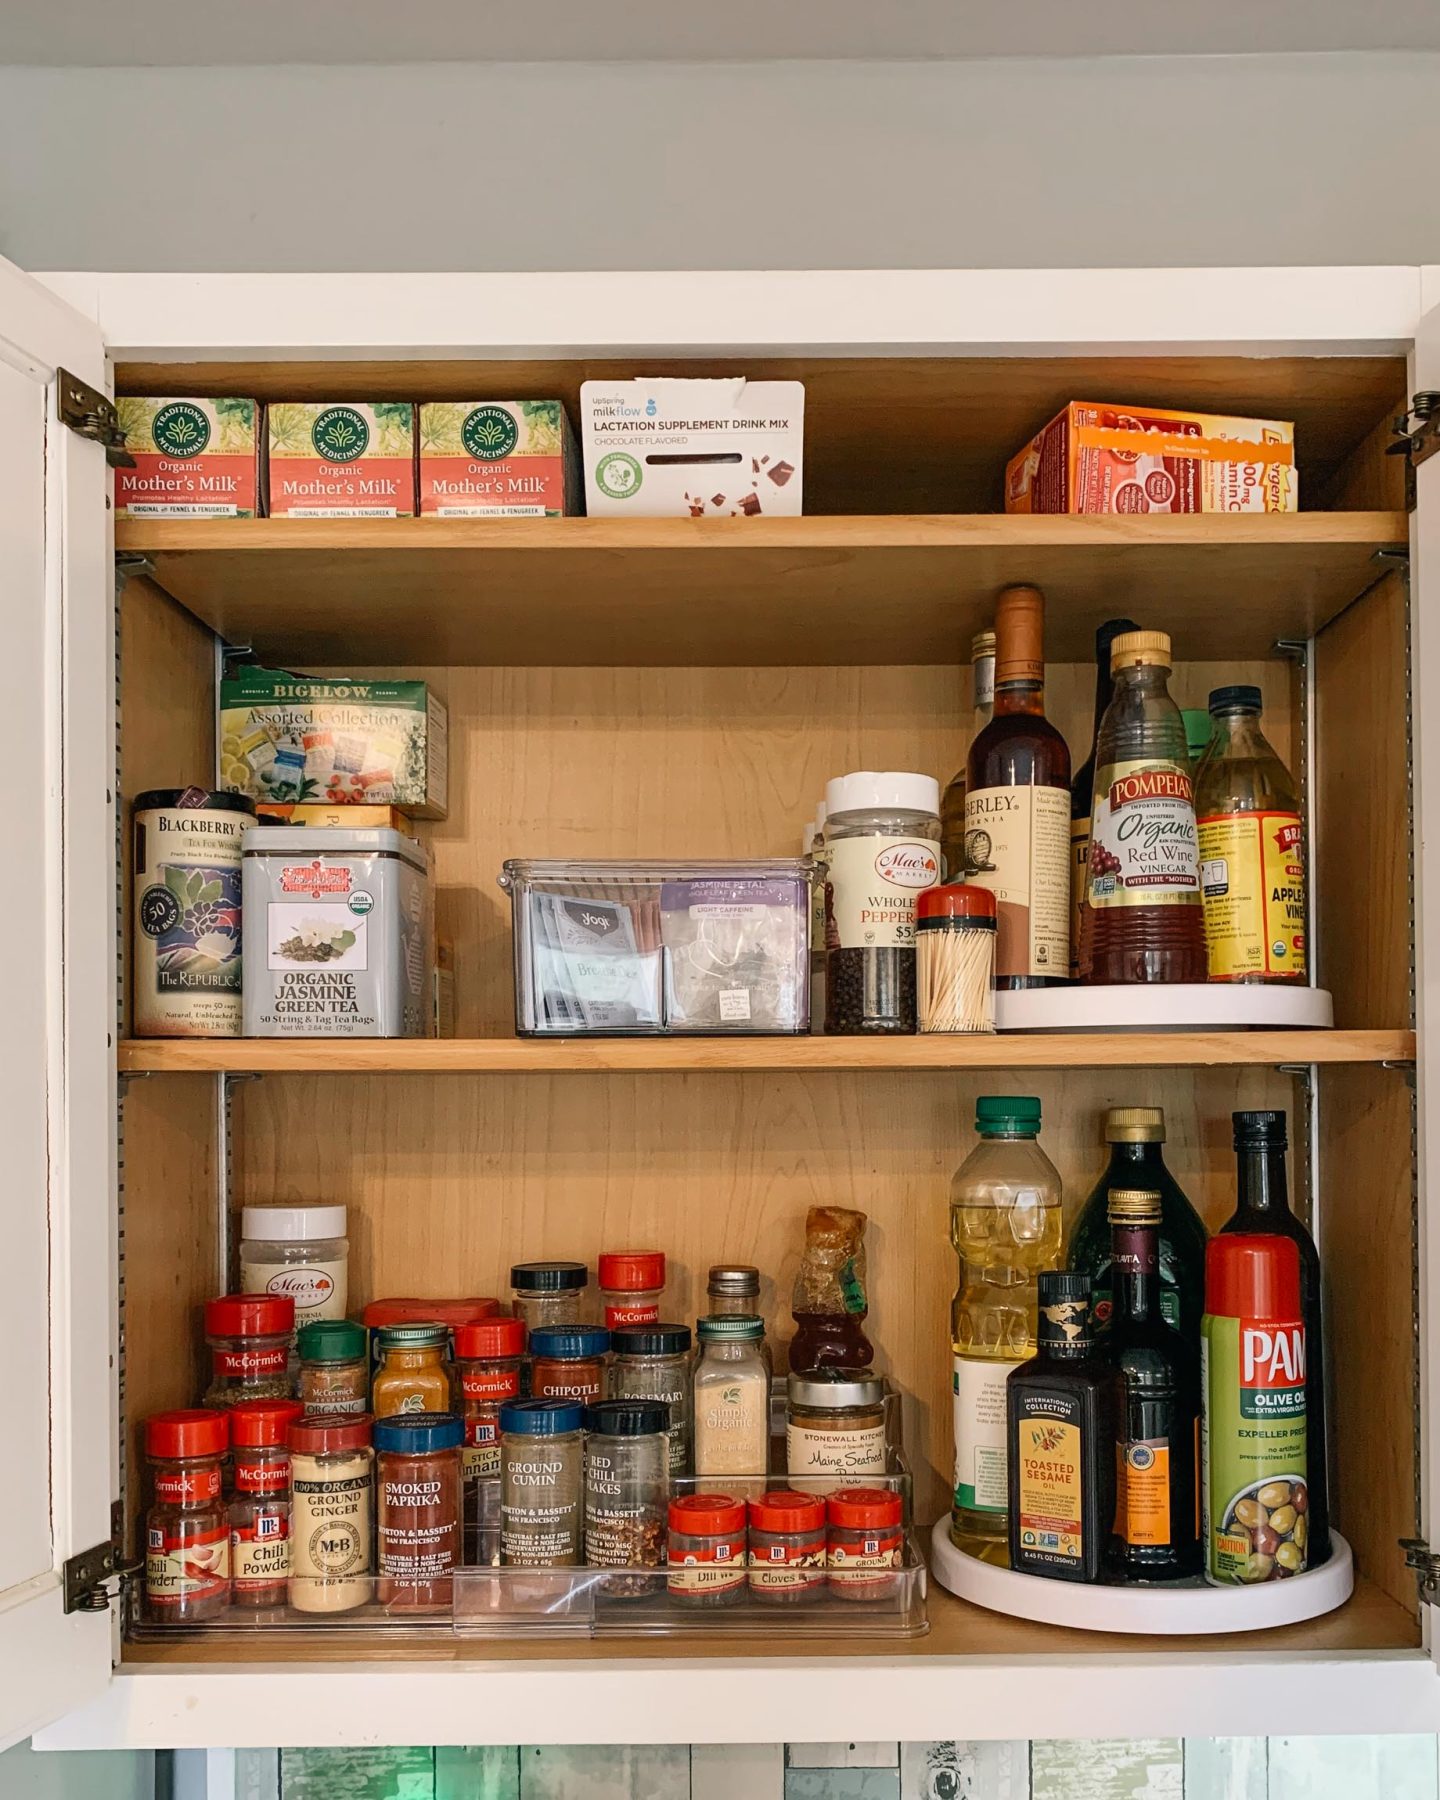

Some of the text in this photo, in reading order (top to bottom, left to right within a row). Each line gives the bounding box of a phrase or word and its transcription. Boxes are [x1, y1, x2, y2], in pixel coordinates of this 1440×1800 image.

[157, 406, 206, 428] TRADITIONAL
[593, 406, 641, 416] milkflow
[316, 410, 365, 432] TRADITIONAL
[465, 409, 514, 431] TRADITIONAL
[593, 419, 789, 432] LACTATION SUPPLEMENT DRINK MIX
[158, 437, 205, 456] MEDICINALS
[594, 436, 688, 446] CHOCOLATE FLAVORED
[317, 440, 364, 460] MEDICINALS
[466, 439, 513, 458] MEDICINALS
[158, 460, 203, 473] Organic
[319, 465, 363, 477] Organic
[468, 463, 512, 476] Organic
[122, 475, 194, 491] Mother's
[283, 479, 354, 495] Mother's
[432, 478, 504, 494] Mother's
[1241, 488, 1250, 504] mg
[273, 685, 371, 697] BIGELOW
[246, 710, 399, 725] Assorted Collection
[1115, 774, 1193, 803] POMPEIAN
[159, 816, 236, 835] BLACKBERRY
[1117, 813, 1194, 849] Organic
[879, 852, 925, 868] Mac's
[1128, 846, 1193, 863] Red Wine
[1139, 864, 1187, 873] VINEGAR
[691, 881, 732, 889] JASMINE
[1127, 876, 1165, 885] WITH THE
[868, 896, 917, 908] WHOLE
[148, 902, 166, 921] 50
[147, 923, 160, 933] TEA
[162, 908, 177, 930] BAGS
[160, 971, 235, 987] The REPUBLIC
[283, 973, 353, 985] ORGANIC
[275, 986, 357, 1000] JASMINE
[275, 1000, 359, 1012] GREEN TEA
[259, 1014, 375, 1025] 50 String & Tag Tea Bags
[270, 1277, 315, 1291] Mac's
[226, 1352, 284, 1368] McCormick
[312, 1386, 355, 1397] McCormick
[543, 1384, 600, 1396] CHIPOTLE
[1024, 1397, 1073, 1409] INTERNATIONAL
[1254, 1393, 1293, 1406] OLIVE
[306, 1401, 359, 1415] ORGANIC
[1025, 1403, 1072, 1415] COLLECTION
[706, 1417, 753, 1430] Organic
[804, 1433, 857, 1442] STONEWALL
[1238, 1429, 1288, 1438] EXPELLER
[471, 1450, 500, 1463] STICK
[591, 1455, 611, 1469] RED
[808, 1449, 844, 1467] Maine
[844, 1448, 883, 1467] Seafood
[507, 1461, 563, 1474] GROUND
[1023, 1458, 1075, 1475] TOASTED
[512, 1474, 557, 1485] CUMIN
[588, 1468, 615, 1481] CHILI
[1026, 1469, 1072, 1484] SESAME
[294, 1482, 319, 1493] 100%
[385, 1481, 441, 1494] SMOKED
[1042, 1482, 1056, 1490] OIL
[307, 1491, 361, 1505] GROUND
[386, 1494, 441, 1506] PAPRIKA
[311, 1505, 359, 1517] GINGER
[528, 1508, 536, 1516] &
[538, 1504, 573, 1516] BASSETT
[604, 1509, 640, 1518] BASSETT
[520, 1516, 560, 1524] FRANCISCO
[408, 1524, 453, 1537] & BASSETT
[399, 1536, 441, 1545] FRANCISCO
[252, 1544, 284, 1561] Chili
[1044, 1554, 1053, 1562] OZ
[420, 1557, 452, 1567] NON-GMO
[855, 1556, 888, 1567] GROUND
[385, 1564, 443, 1573] PRESERVATIVE FREE
[761, 1572, 796, 1584] Cloves
